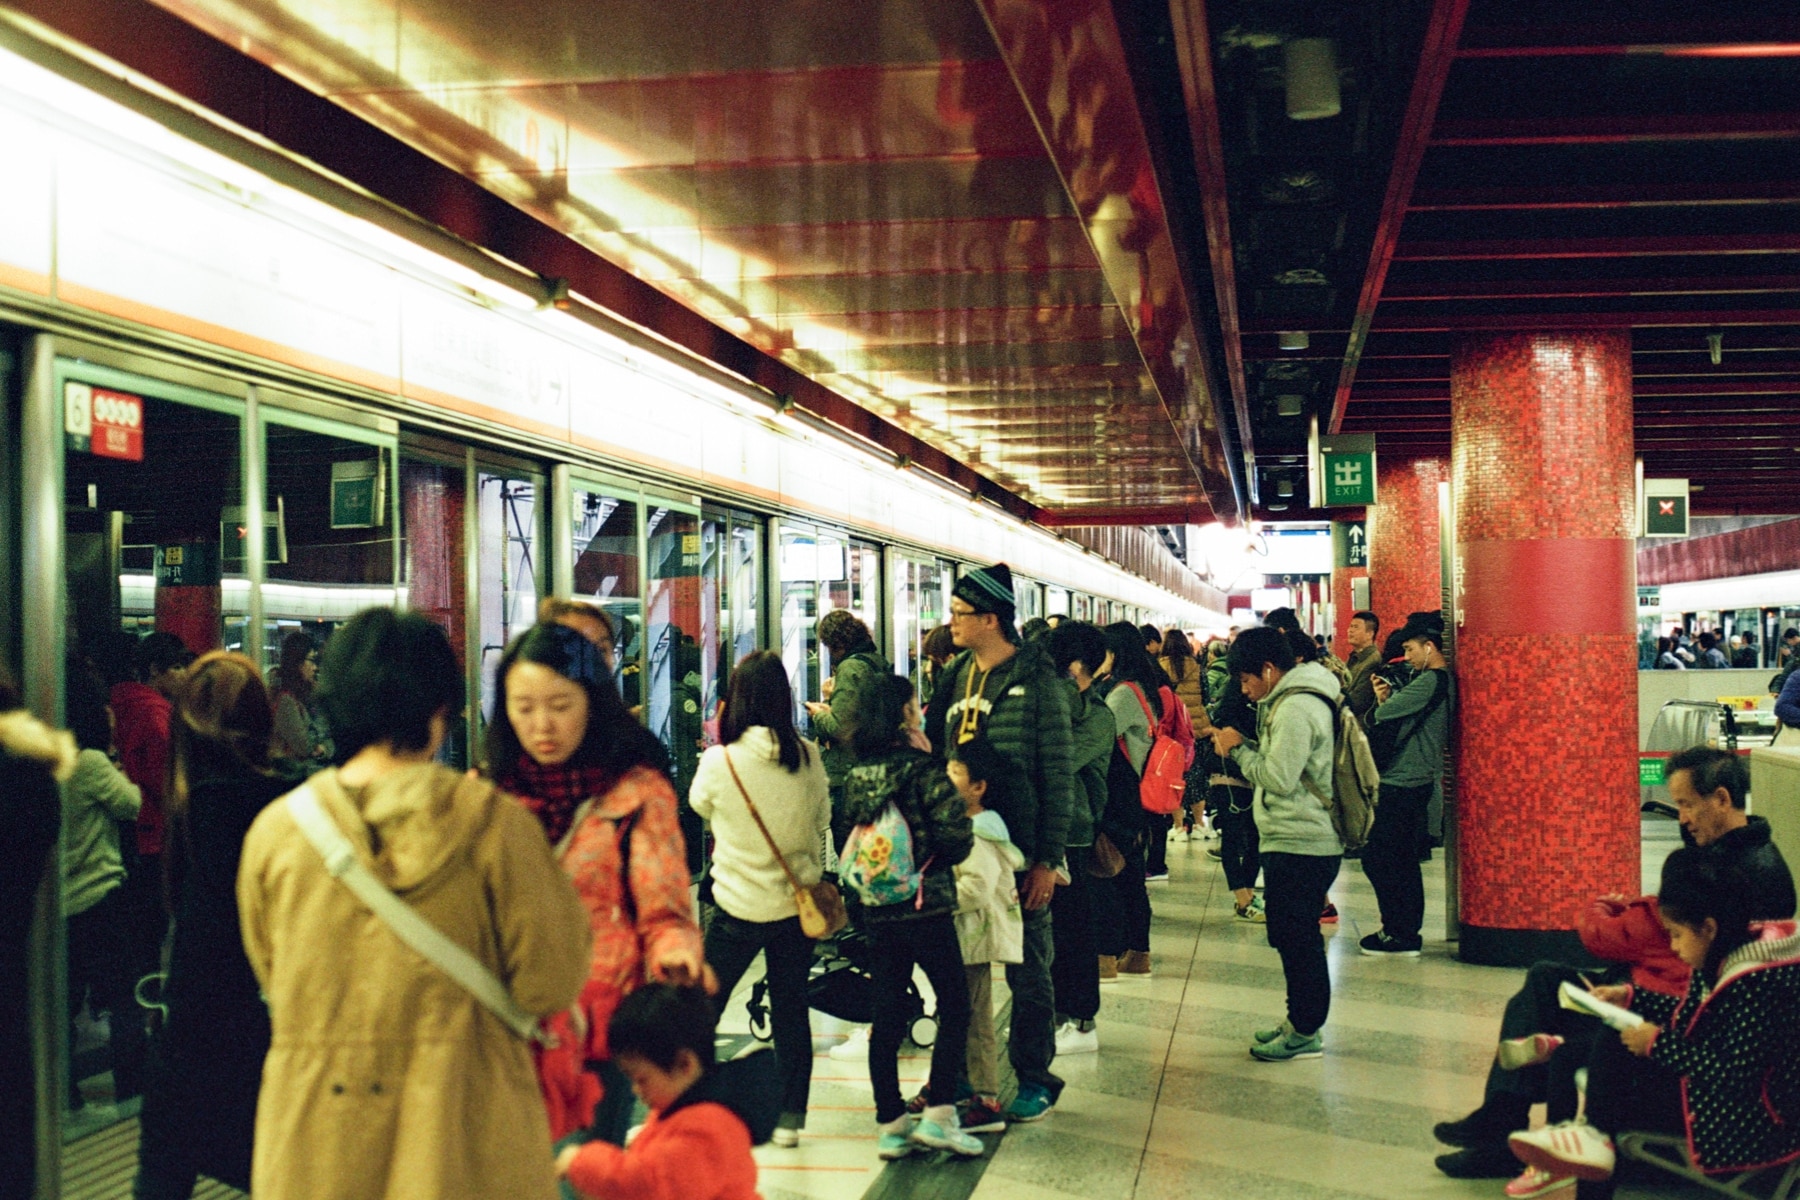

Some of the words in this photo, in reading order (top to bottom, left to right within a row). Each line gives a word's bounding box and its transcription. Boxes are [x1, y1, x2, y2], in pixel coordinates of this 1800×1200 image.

[72, 393, 84, 427] 6
[1334, 461, 1362, 486] 出
[1335, 486, 1361, 496] EXIT
